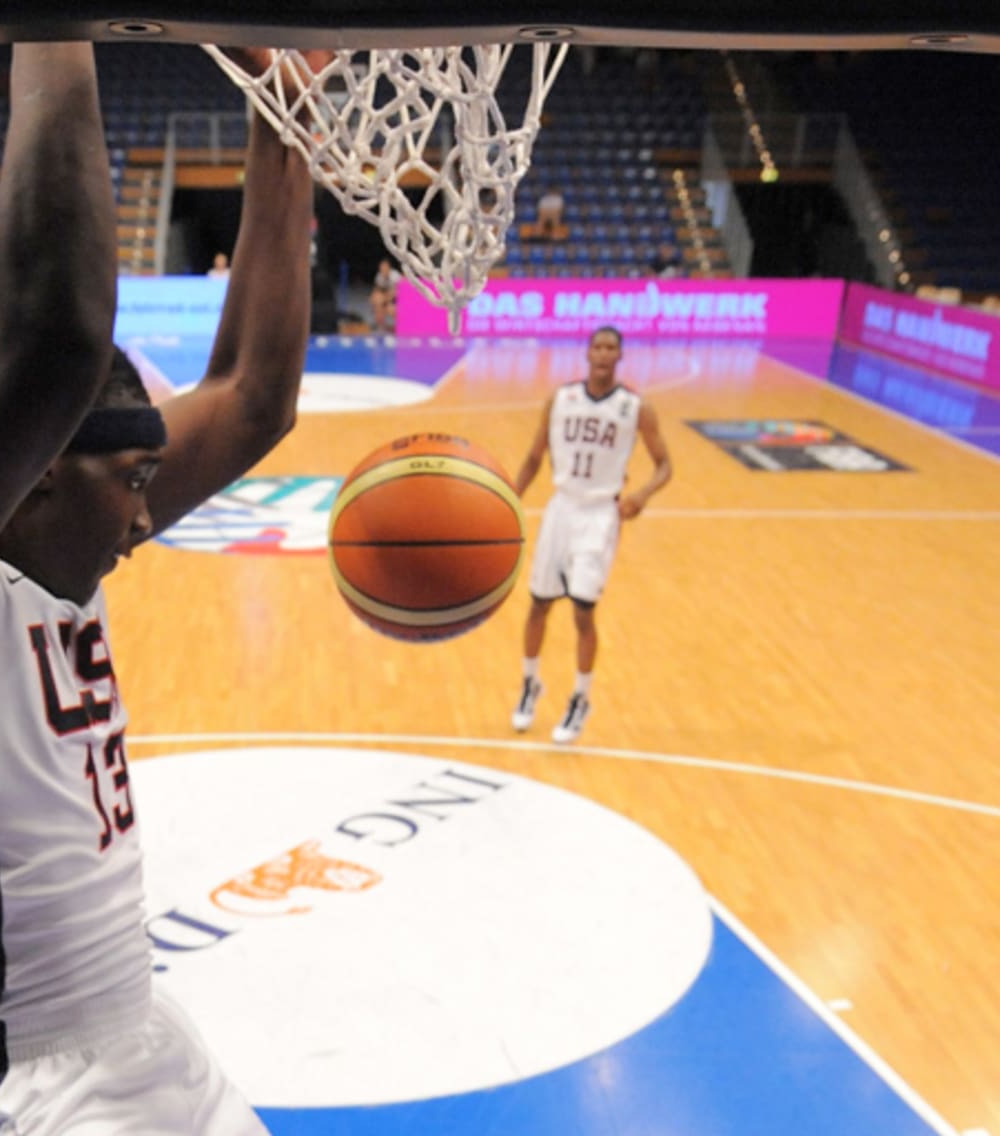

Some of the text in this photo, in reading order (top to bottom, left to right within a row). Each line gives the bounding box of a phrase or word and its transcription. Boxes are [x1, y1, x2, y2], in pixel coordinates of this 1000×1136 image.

[468, 281, 768, 318] DAS HANDWERK
[564, 416, 617, 448] USA
[571, 451, 593, 478] 11
[27, 617, 118, 737] US
[84, 730, 135, 853] 13
[334, 768, 510, 847] ING
